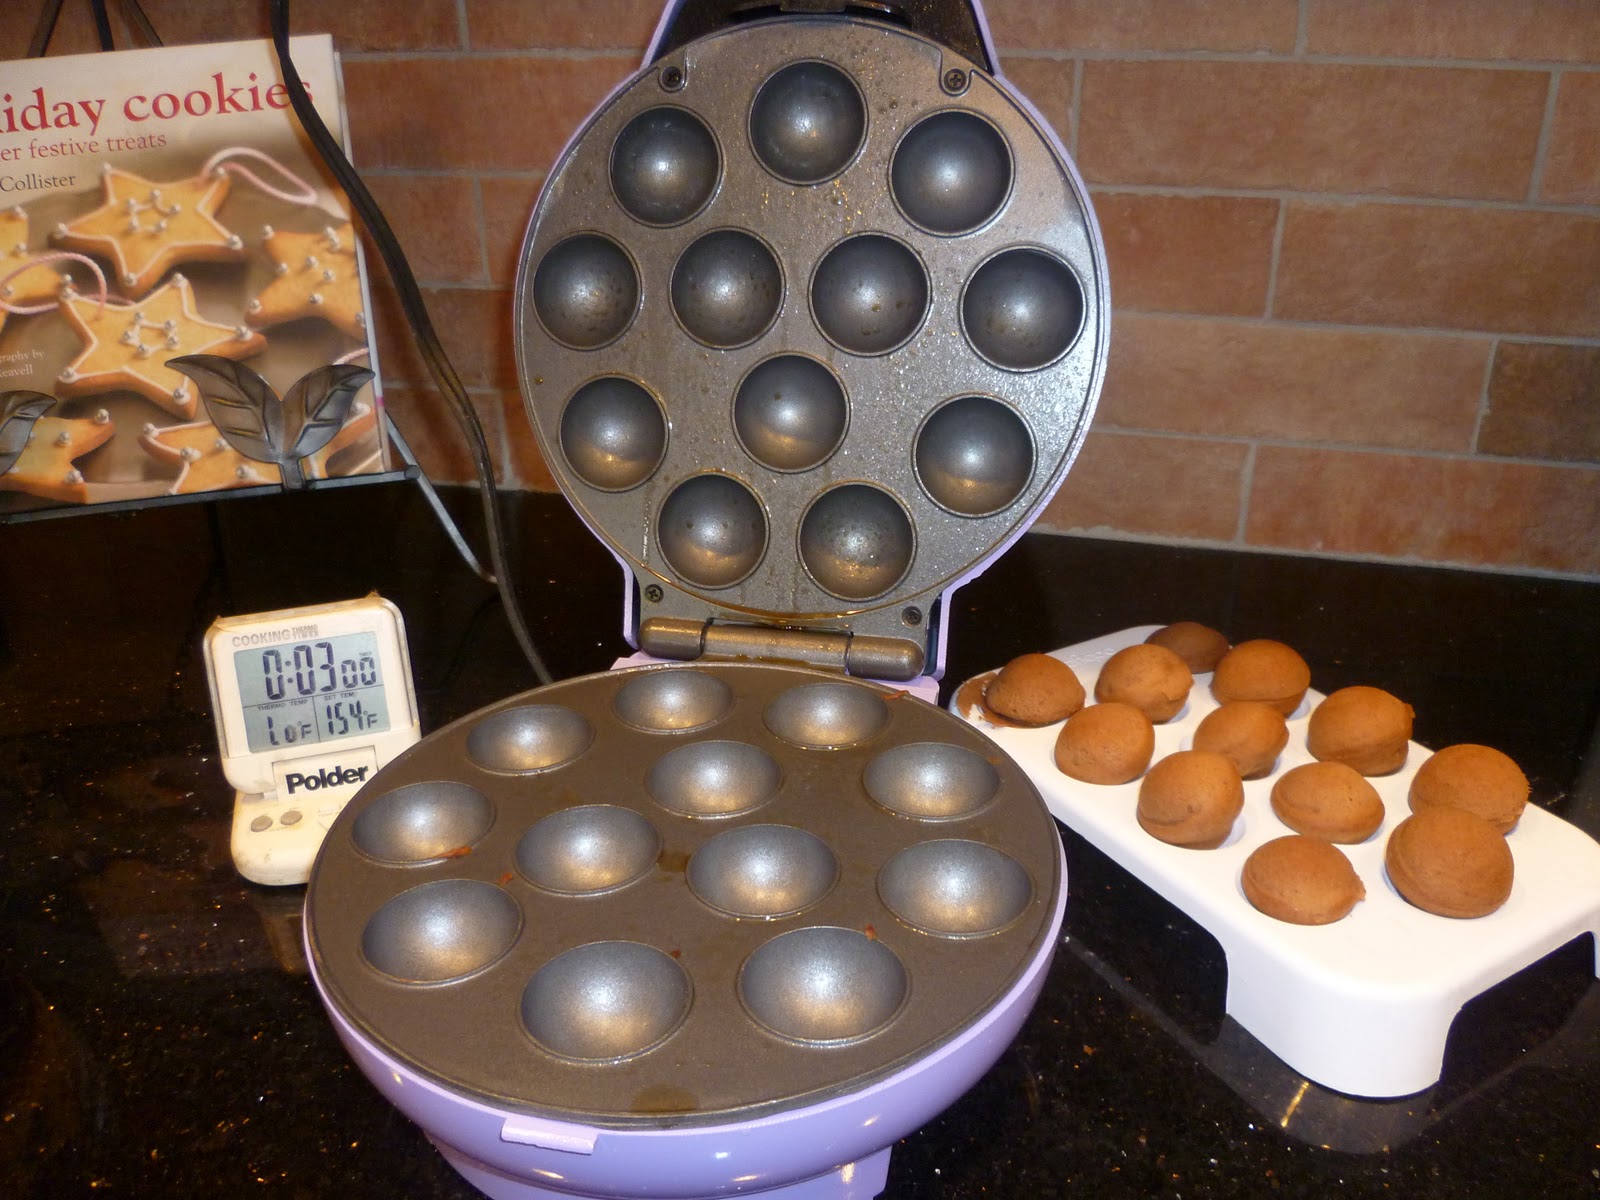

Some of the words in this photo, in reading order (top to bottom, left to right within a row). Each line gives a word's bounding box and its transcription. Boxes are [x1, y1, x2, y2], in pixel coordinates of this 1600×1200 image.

[0, 87, 106, 136] iday
[29, 138, 100, 159] festive
[106, 133, 167, 152] treats
[0, 174, 76, 192] Collister
[0, 364, 33, 378] eavell
[291, 624, 318, 633] THERMO
[292, 630, 320, 640] TIMER
[232, 629, 291, 647] COOKING
[286, 765, 369, 795] Polder
